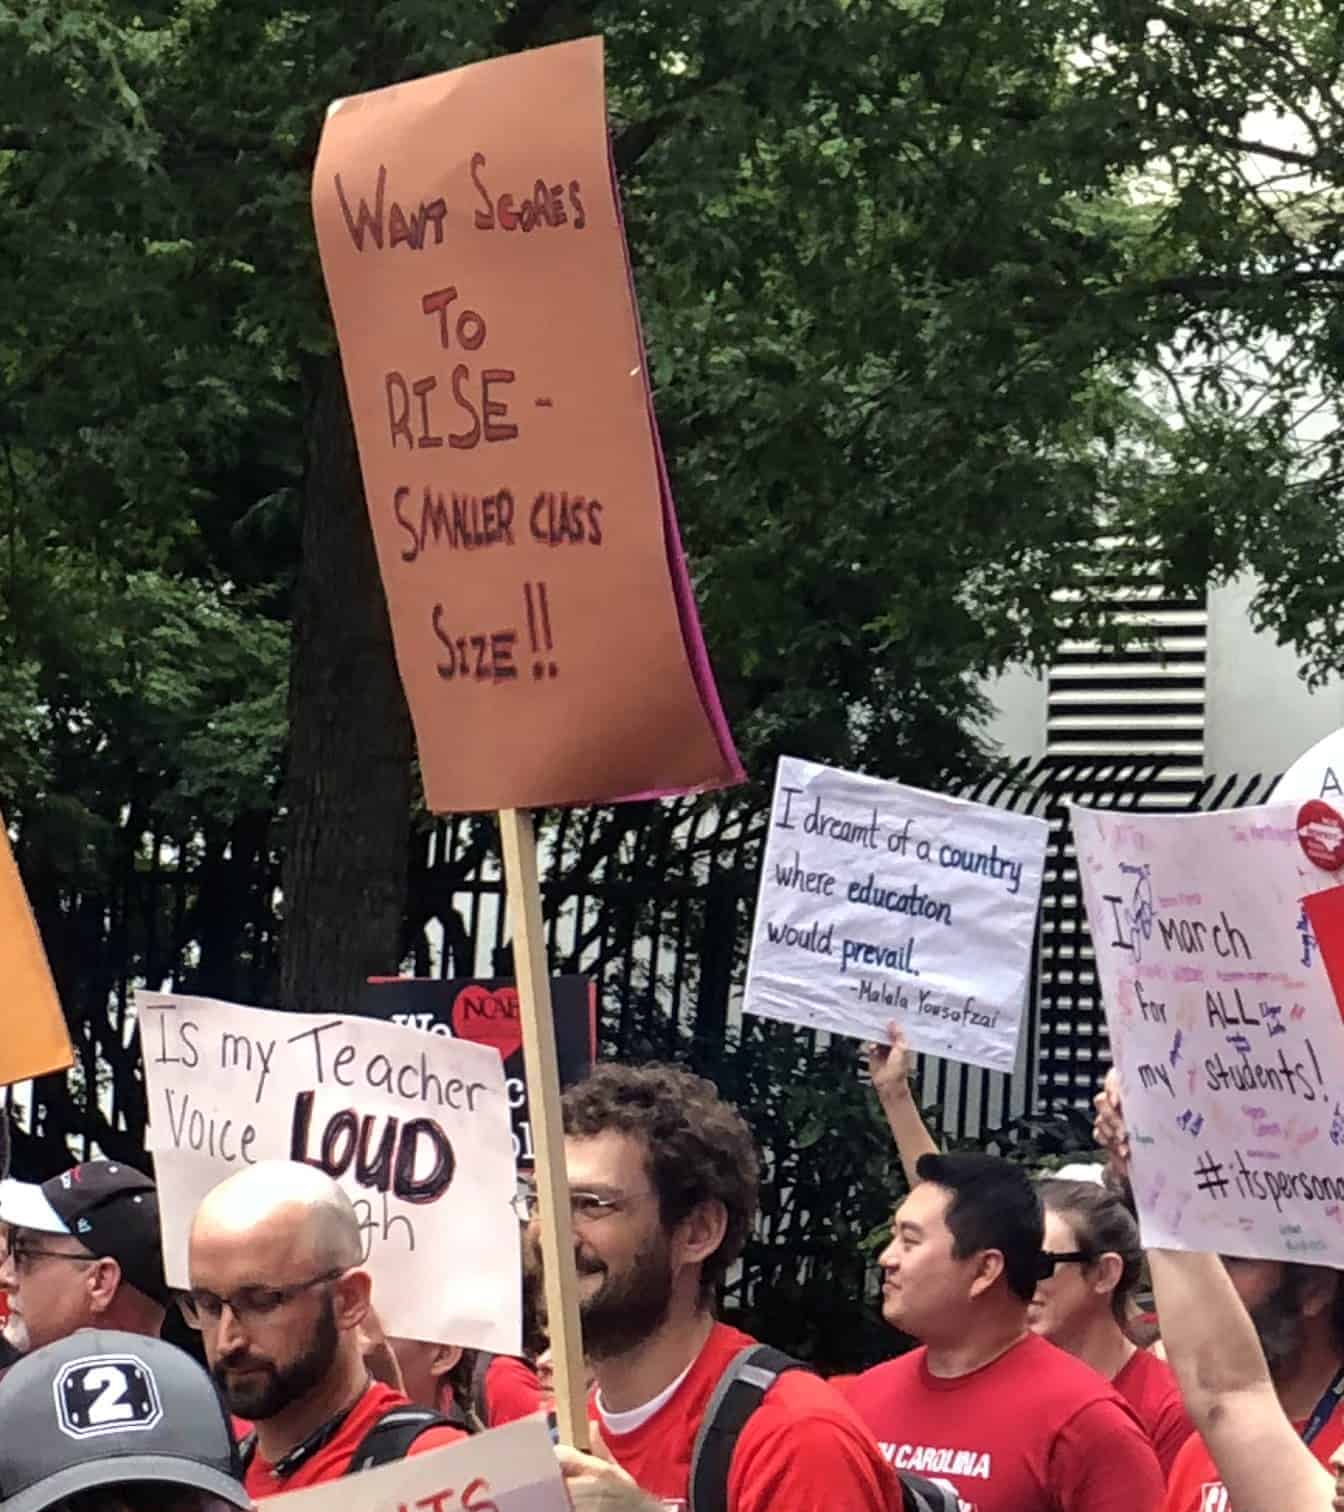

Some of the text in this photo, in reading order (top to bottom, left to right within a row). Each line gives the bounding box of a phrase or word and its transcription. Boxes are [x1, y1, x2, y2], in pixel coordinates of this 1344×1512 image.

[776, 786, 1023, 894] I dreamt of a country
[776, 851, 952, 926] where education
[768, 920, 920, 976] would prevail.
[1103, 894, 1135, 950] I
[1135, 979, 1167, 1024] for
[1205, 988, 1261, 1029] ALL
[146, 1004, 200, 1068] Is
[221, 1032, 276, 1103] my
[288, 1020, 488, 1112] Teacher
[1138, 1063, 1176, 1099] my
[1204, 1038, 1328, 1103] students!
[166, 1088, 456, 1205] Voice LOUD
[1193, 1149, 1344, 1213] #itspersona
[82, 1366, 133, 1424] 2
[895, 1443, 990, 1479] CAROLINA
